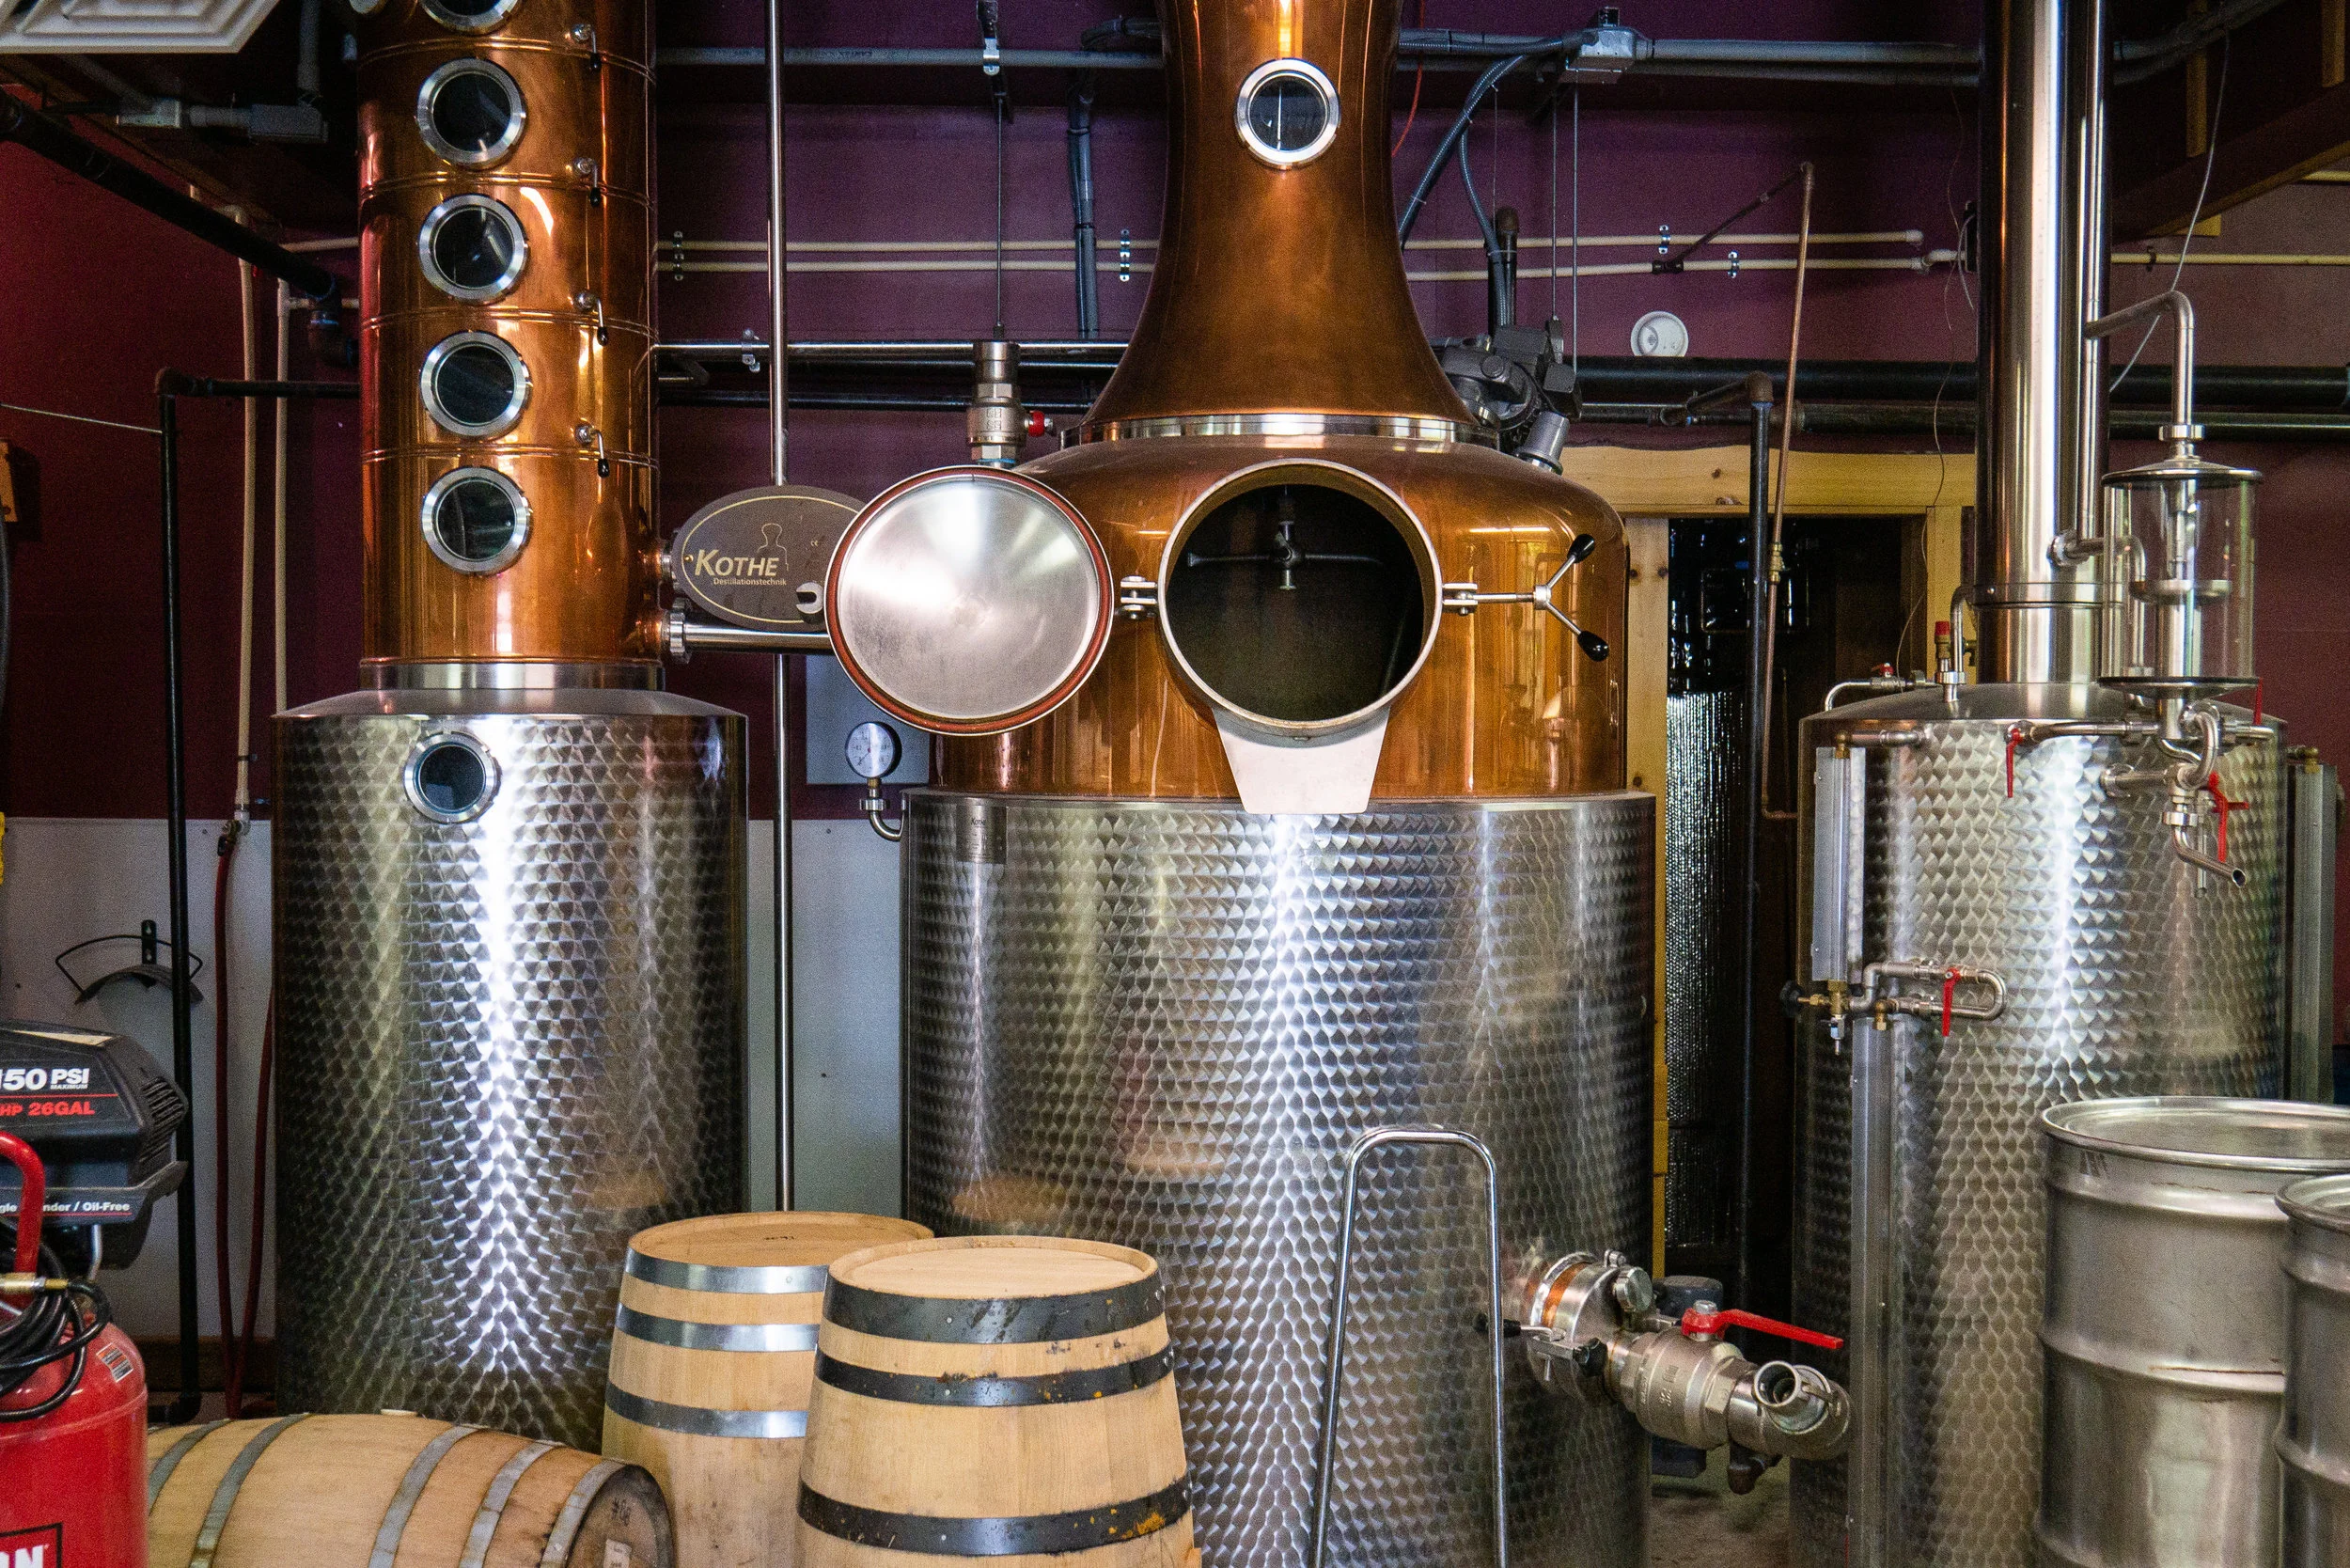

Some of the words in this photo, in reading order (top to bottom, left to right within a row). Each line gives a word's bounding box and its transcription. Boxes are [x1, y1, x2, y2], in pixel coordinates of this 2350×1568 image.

[695, 549, 779, 576] KOTHE
[713, 577, 787, 586] Destillationstechnik
[0, 1068, 47, 1090] 50
[51, 1068, 90, 1085] PSI
[27, 1101, 96, 1116] 26GAL
[82, 1201, 131, 1212] Oil-Free
